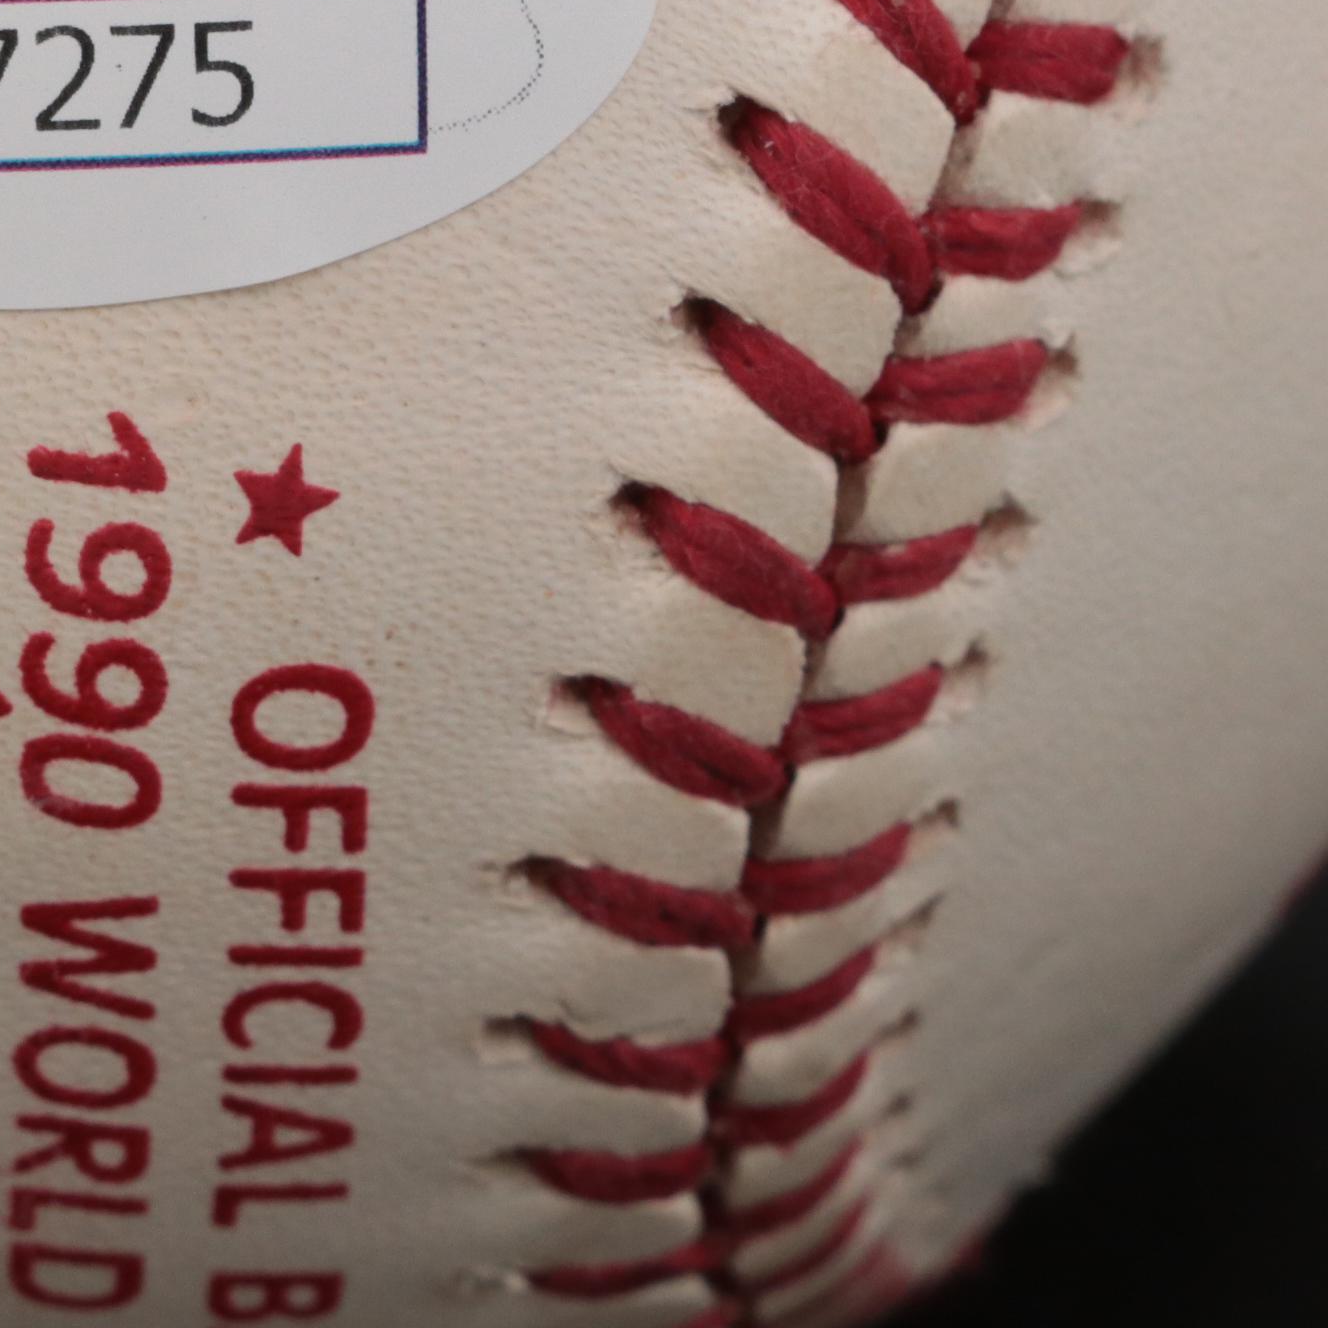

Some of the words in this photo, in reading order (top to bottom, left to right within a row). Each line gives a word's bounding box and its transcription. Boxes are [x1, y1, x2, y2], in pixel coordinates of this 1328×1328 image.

[17, 409, 174, 832] 1990
[6, 893, 161, 1312] WORLD
[208, 661, 377, 1229] OFFICIAL
